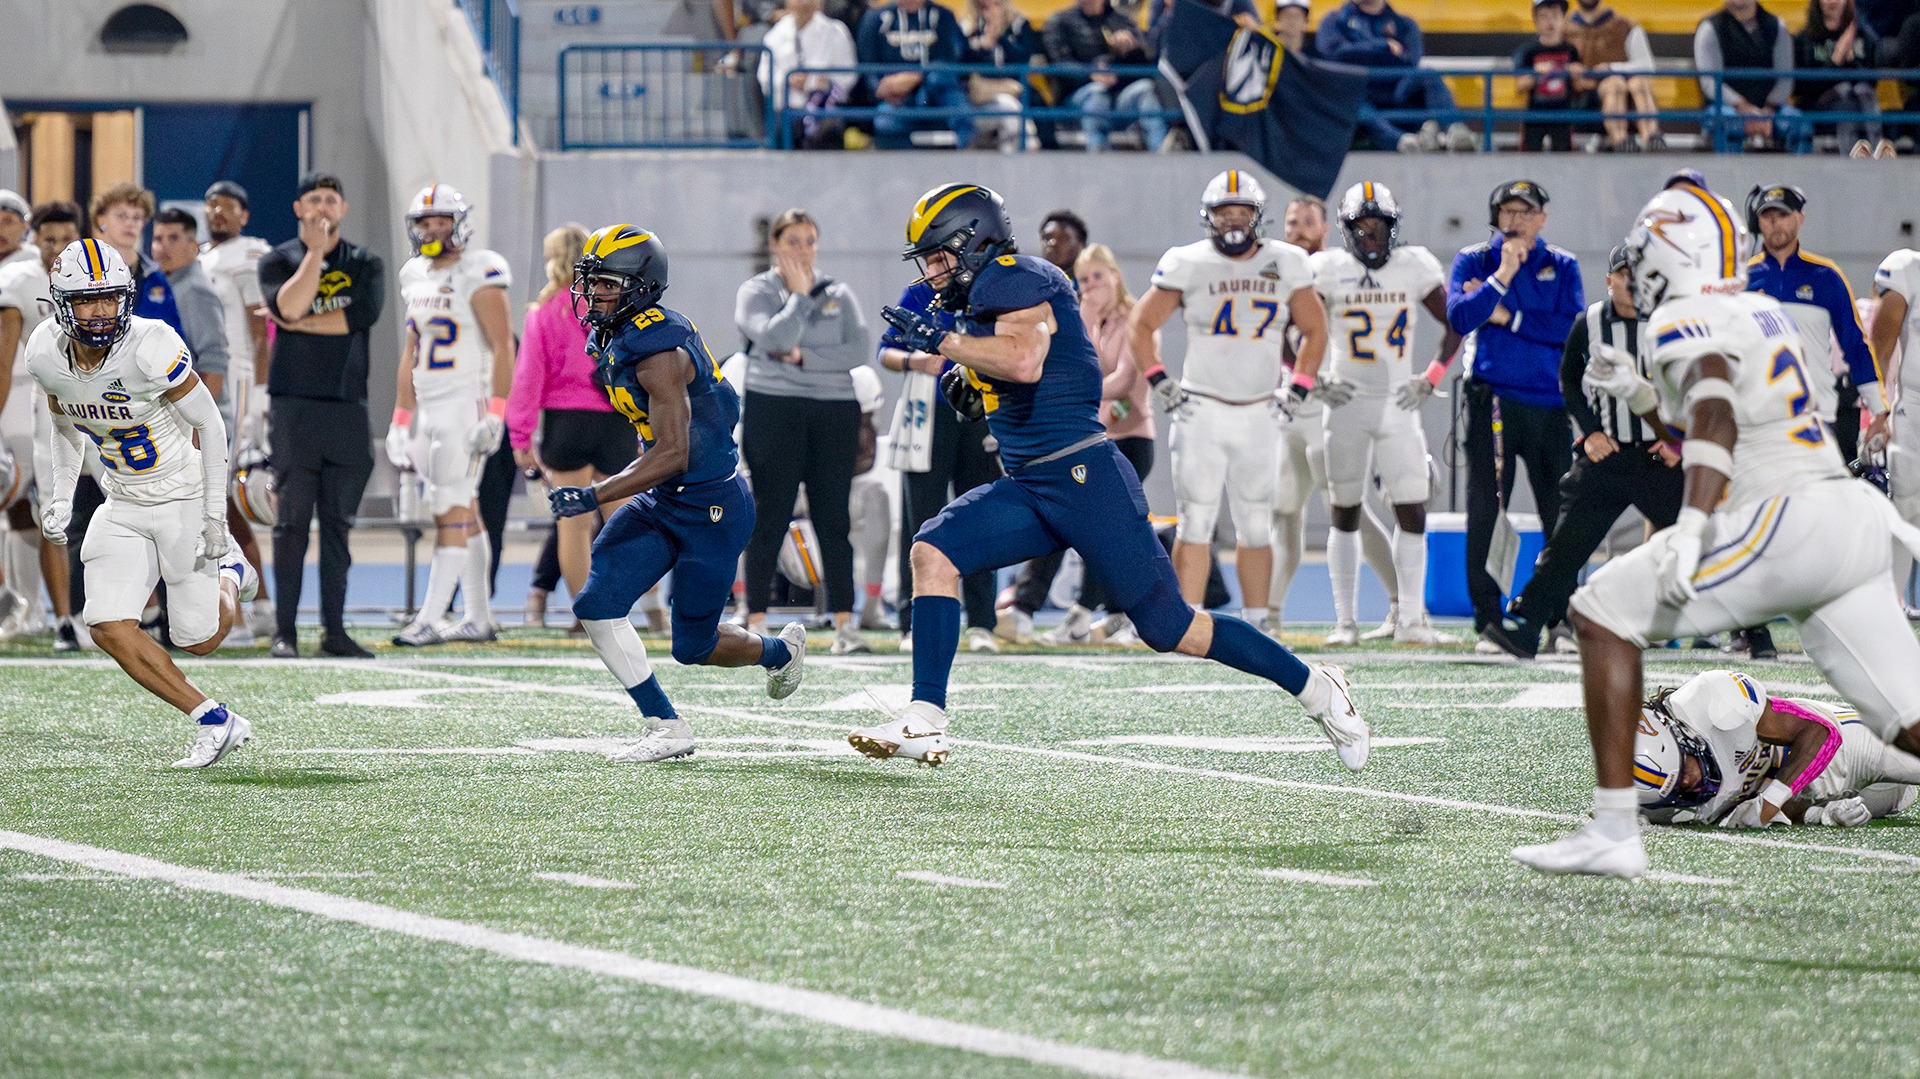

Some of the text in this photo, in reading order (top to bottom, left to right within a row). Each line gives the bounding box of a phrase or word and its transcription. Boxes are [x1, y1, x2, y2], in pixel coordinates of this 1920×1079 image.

[1208, 279, 1276, 295] LAURIER
[1345, 292, 1406, 304] LAURIER
[631, 307, 666, 331] 29
[1210, 296, 1279, 340] 47
[1343, 306, 1408, 361] 24
[60, 403, 134, 420] LAURIER
[72, 421, 161, 474] 28
